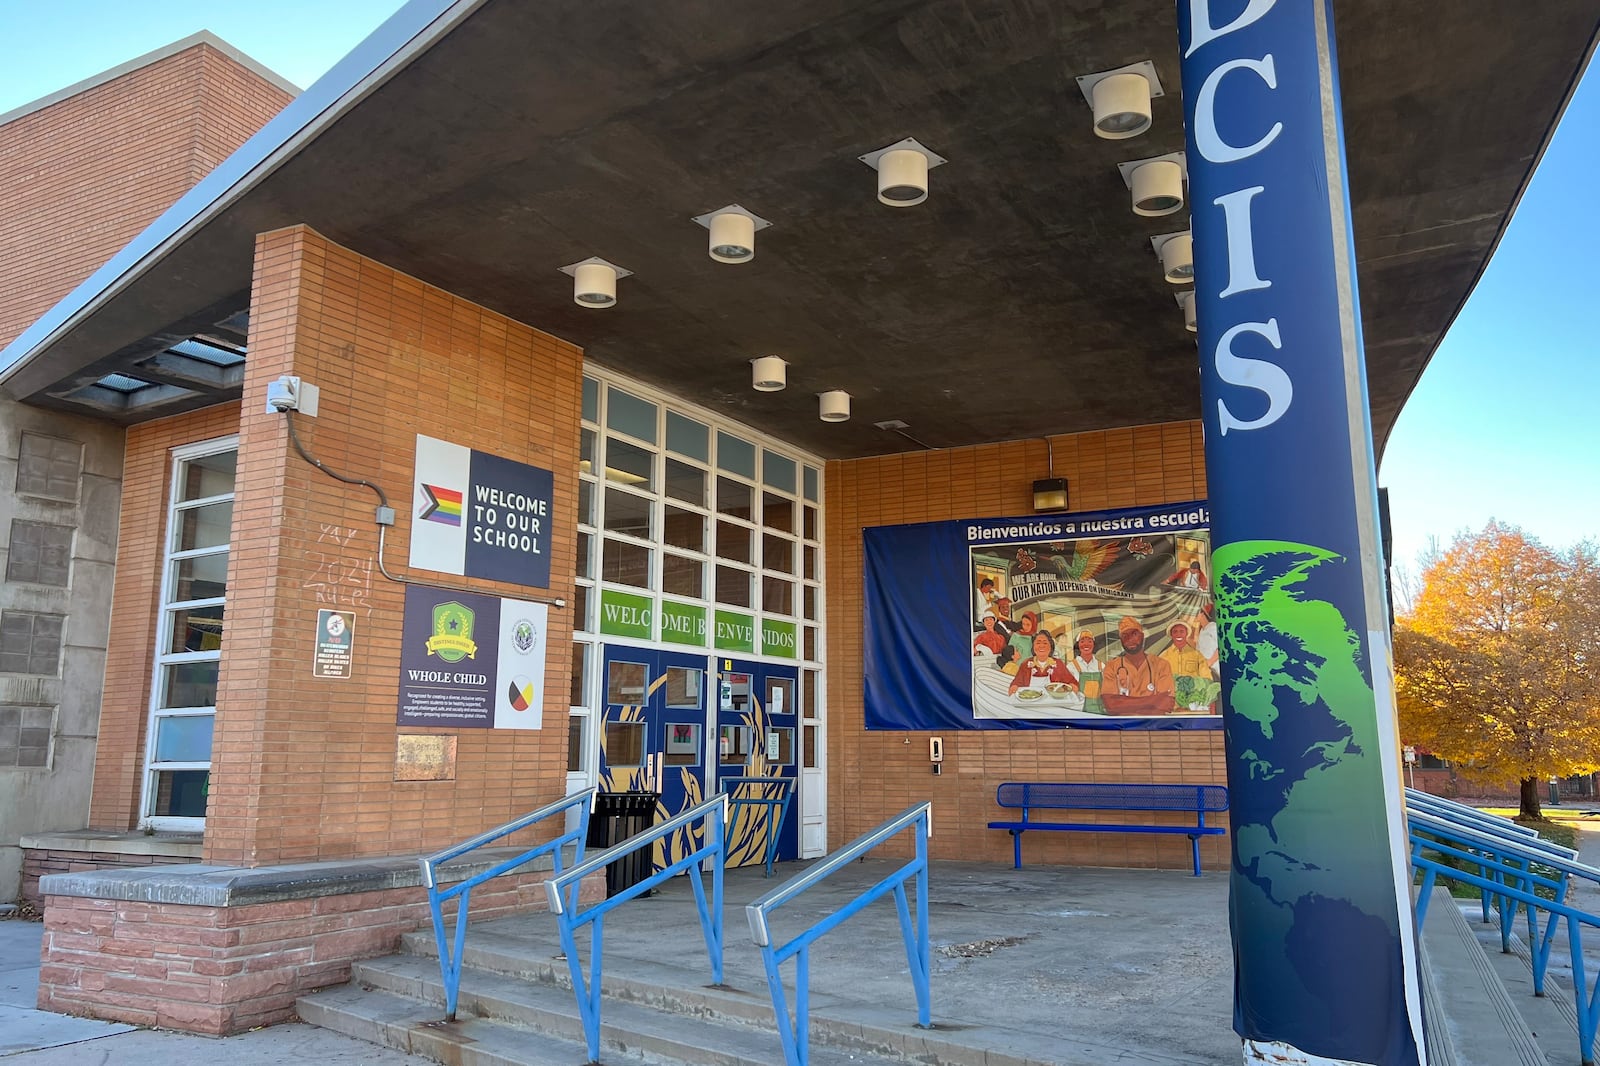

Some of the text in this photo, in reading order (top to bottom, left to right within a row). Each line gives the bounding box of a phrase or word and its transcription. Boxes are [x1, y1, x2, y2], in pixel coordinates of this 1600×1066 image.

[475, 484, 547, 516] WELCOME
[475, 505, 540, 535] TO OUR
[967, 522, 1061, 541] Bienvenidos
[1066, 523, 1075, 533] a
[1081, 516, 1144, 532] nuestra
[473, 526, 541, 554] SCHOOL
[303, 550, 372, 597] 2024
[1011, 574, 1026, 586] WE
[1026, 573, 1040, 583] ARE
[1012, 581, 1135, 602] OUR NATION DEPENDS ON IMMIGRANTS
[604, 603, 794, 648] WELCOME BENVENIDOS
[408, 669, 487, 686] WHOLE CHILD
